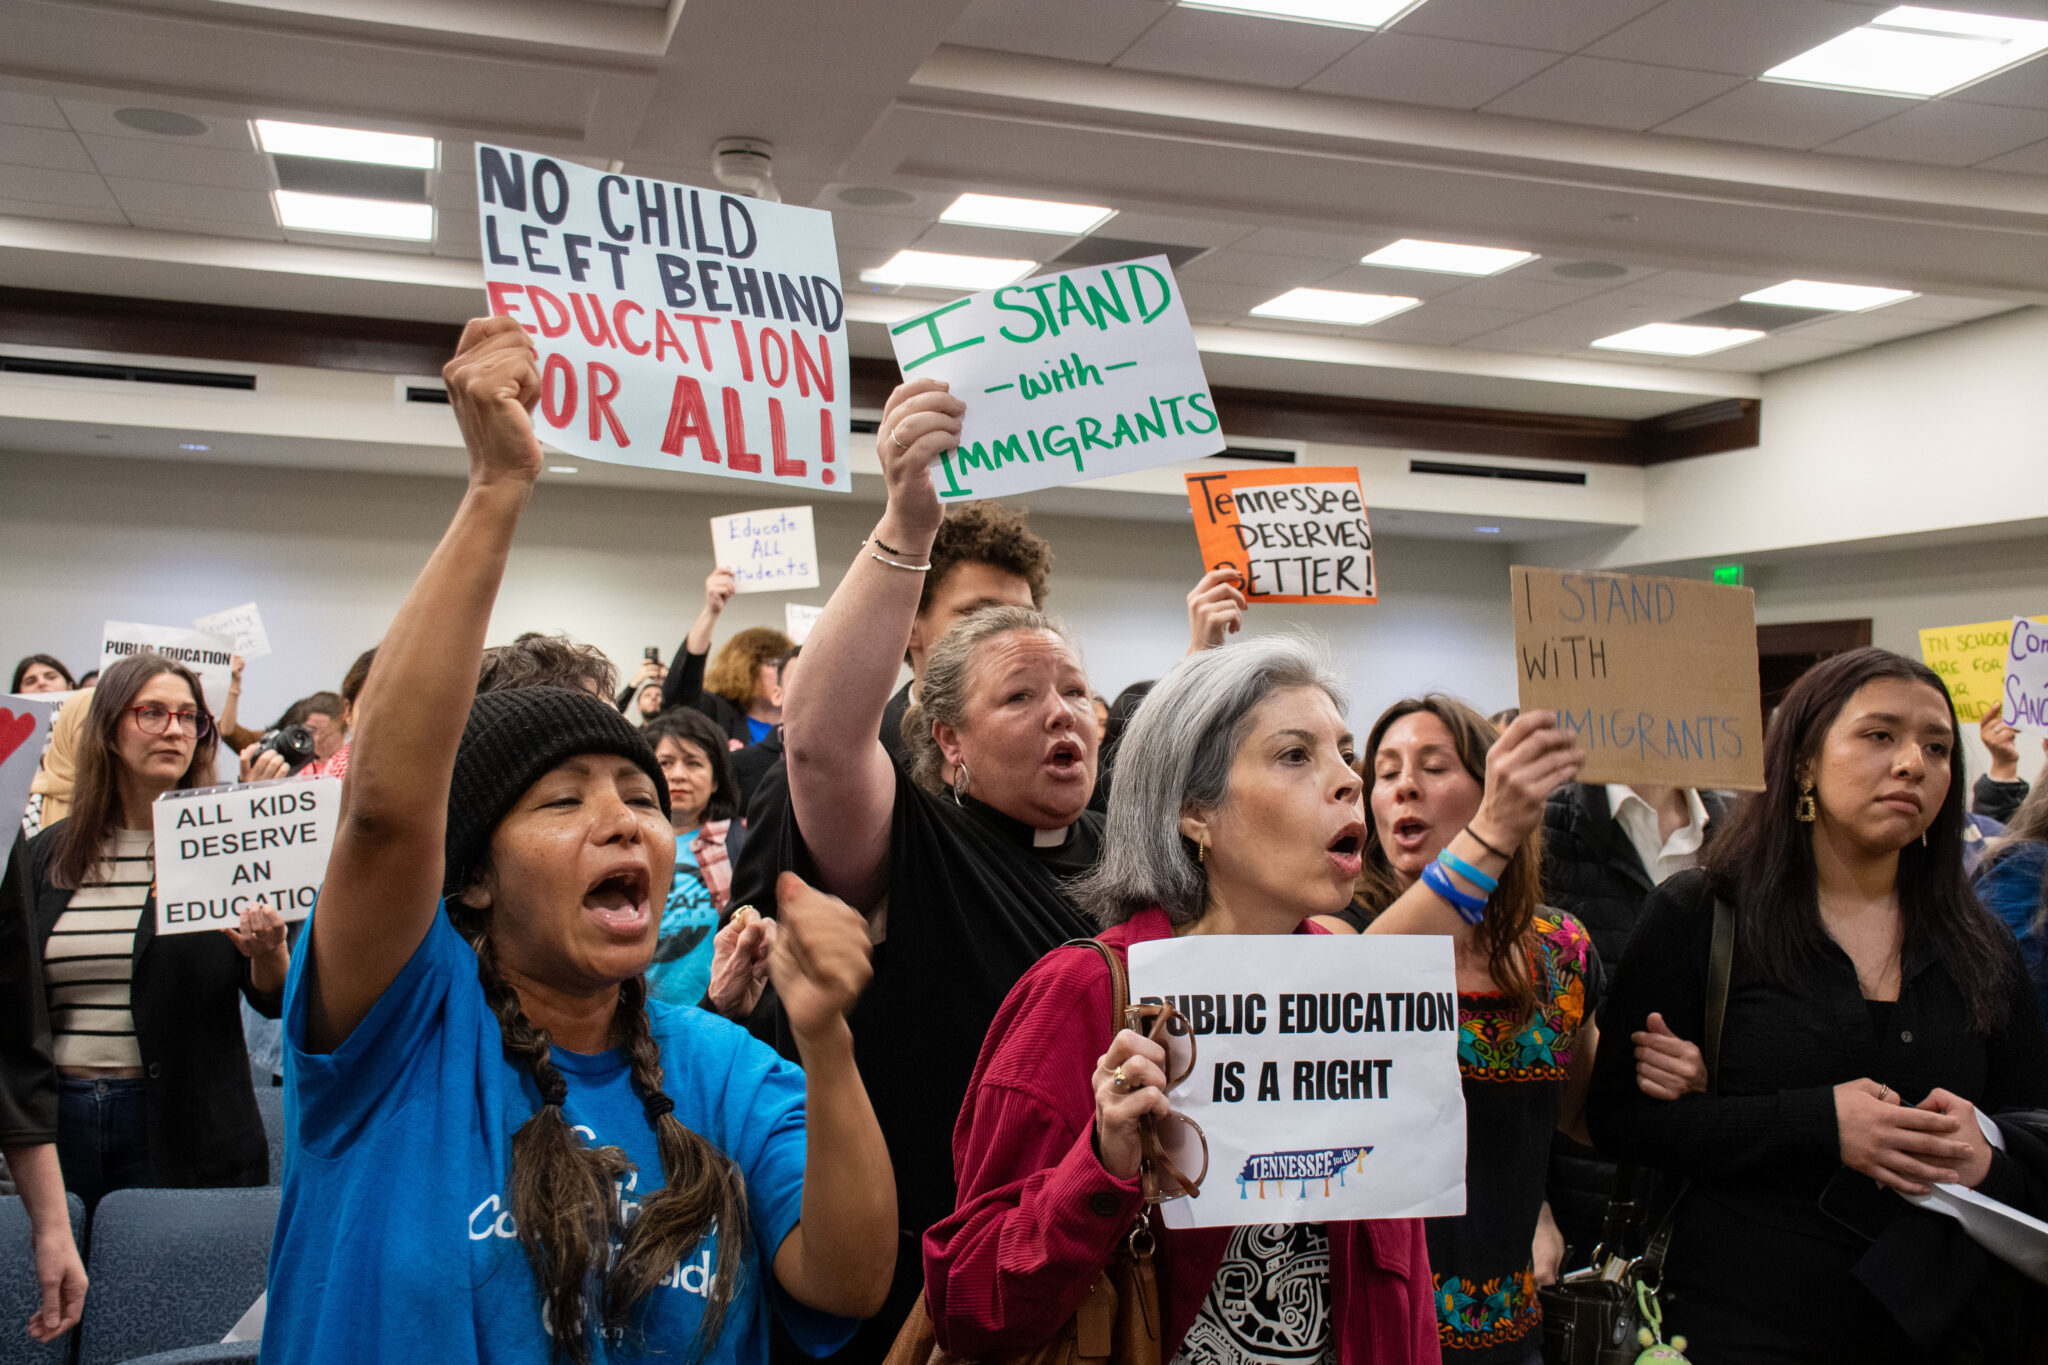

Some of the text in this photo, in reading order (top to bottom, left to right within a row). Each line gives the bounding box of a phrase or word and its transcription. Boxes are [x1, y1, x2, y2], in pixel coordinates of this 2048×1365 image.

[480, 146, 758, 260] NO CHILD
[486, 215, 844, 333] LEFT BEHIND
[892, 264, 1171, 372] I STAND
[487, 281, 835, 403] EDUCATION
[530, 347, 836, 485] OR ALL!
[939, 393, 1218, 498] IMMIGRANTS
[1187, 474, 1362, 524] Tennessee
[729, 512, 797, 540] Educate
[1227, 518, 1371, 551] DESERVES
[752, 539, 782, 559] ALL
[727, 557, 808, 582] tudents
[1525, 571, 1675, 625] I STAND
[159, 645, 231, 666] EDUCATION
[1926, 637, 1949, 652] TN
[1931, 658, 2002, 675] ARE FOR
[1556, 708, 1742, 761] MIGRANTS
[176, 791, 316, 829] ALL KIDS
[181, 822, 317, 860] DESERVE
[232, 860, 271, 885] AN
[166, 886, 317, 923] EDUCTIO
[1278, 991, 1455, 1034] EDUCATION
[1212, 1059, 1392, 1103] IS A RIGHT
[1250, 1151, 1334, 1180] TENNESSEE
